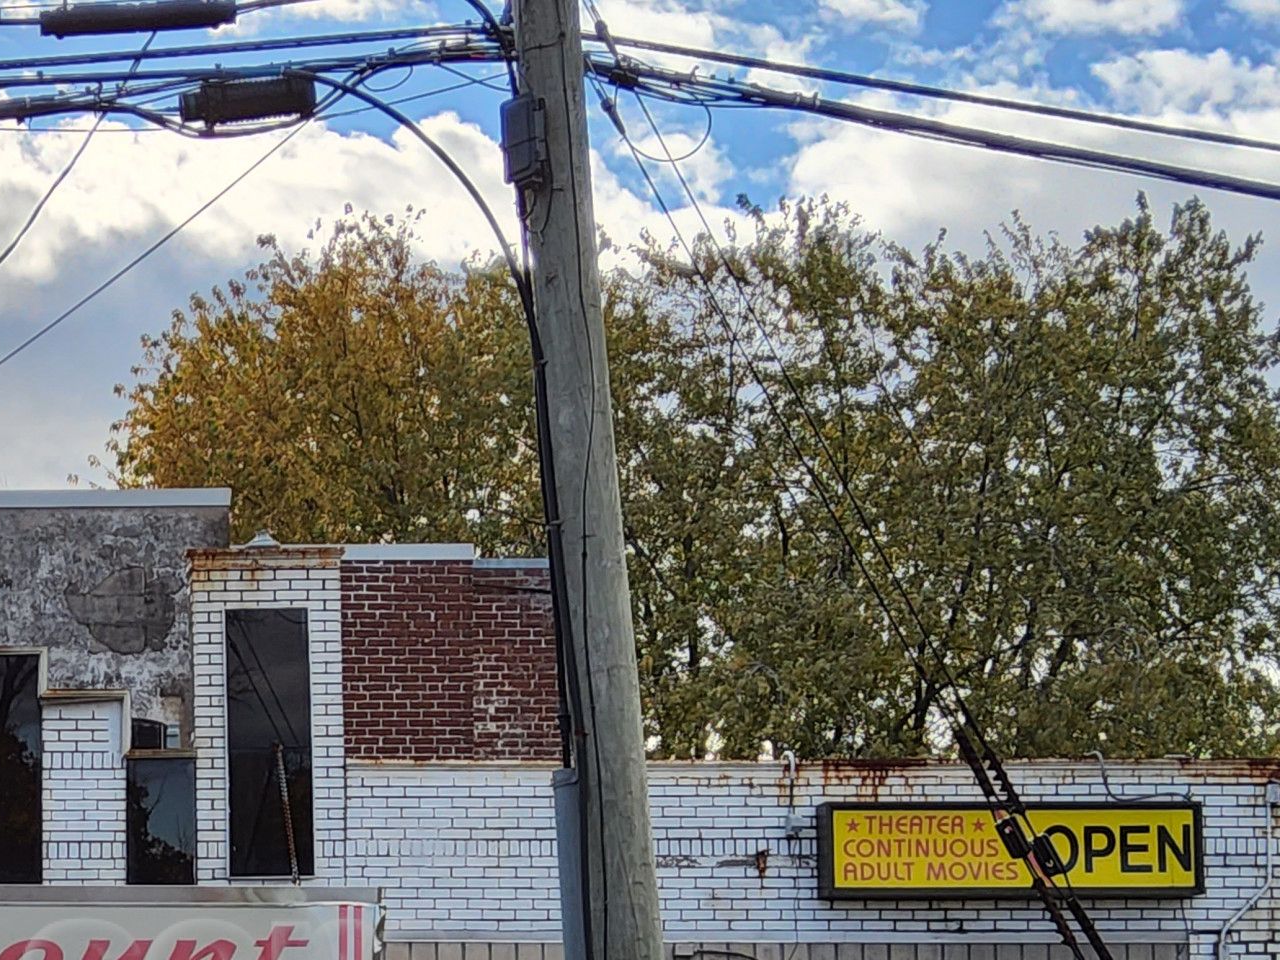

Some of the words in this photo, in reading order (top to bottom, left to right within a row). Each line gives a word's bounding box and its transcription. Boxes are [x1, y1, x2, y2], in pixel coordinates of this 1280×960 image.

[864, 815, 964, 835] THEATER
[843, 838, 999, 858] CONTINUOUS
[1036, 823, 1193, 874] OPEN
[843, 861, 915, 881] ADULT
[926, 861, 1019, 881] MOVIES
